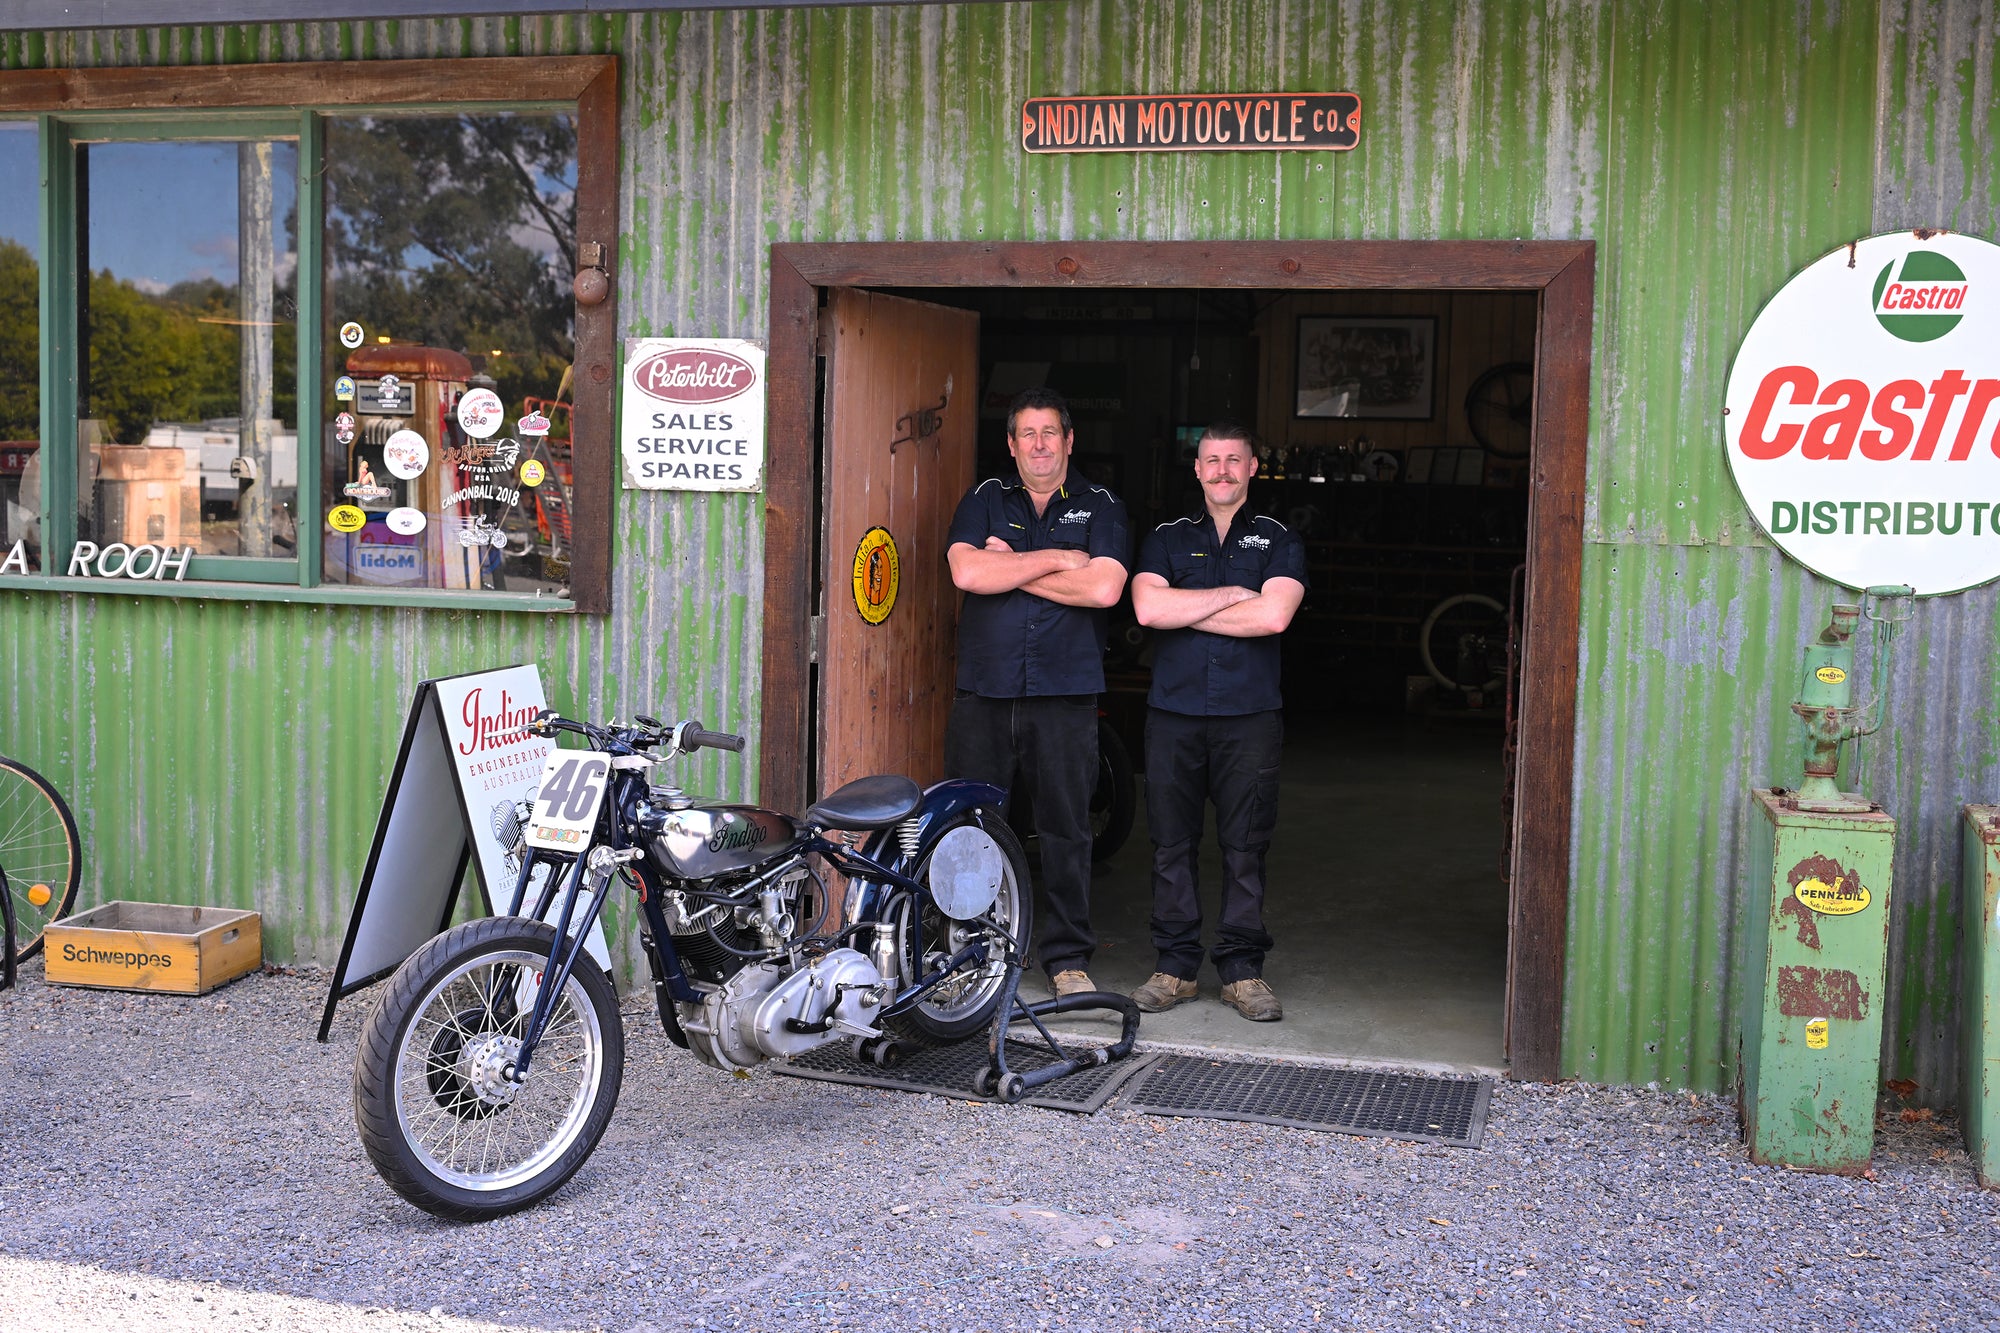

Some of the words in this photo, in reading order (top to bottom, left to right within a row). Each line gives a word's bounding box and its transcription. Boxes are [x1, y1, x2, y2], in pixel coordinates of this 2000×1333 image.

[1038, 103, 1125, 146] INDIAN
[1137, 101, 1307, 144] MOTOCYCLE
[1313, 108, 1345, 133] CO.
[1882, 283, 1969, 310] Castrol
[648, 358, 747, 390] Peterbilt
[652, 413, 733, 431] SALES
[1738, 365, 2000, 461] Castr
[637, 437, 748, 456] SERVICE
[641, 461, 743, 480] SPARES
[441, 485, 494, 509] CANNONBALL
[495, 486, 520, 507] 2018
[0, 539, 30, 576] A
[67, 541, 194, 582] ROOH
[854, 539, 874, 579] Indian
[459, 688, 541, 756] Indian
[469, 746, 547, 777] ENGINEERING
[483, 764, 544, 791] AUSTRALIA
[538, 759, 607, 822] 46
[708, 823, 767, 853] Indigo
[1801, 889, 1865, 902] PENNZOIL
[62, 943, 172, 970] Schweppes
